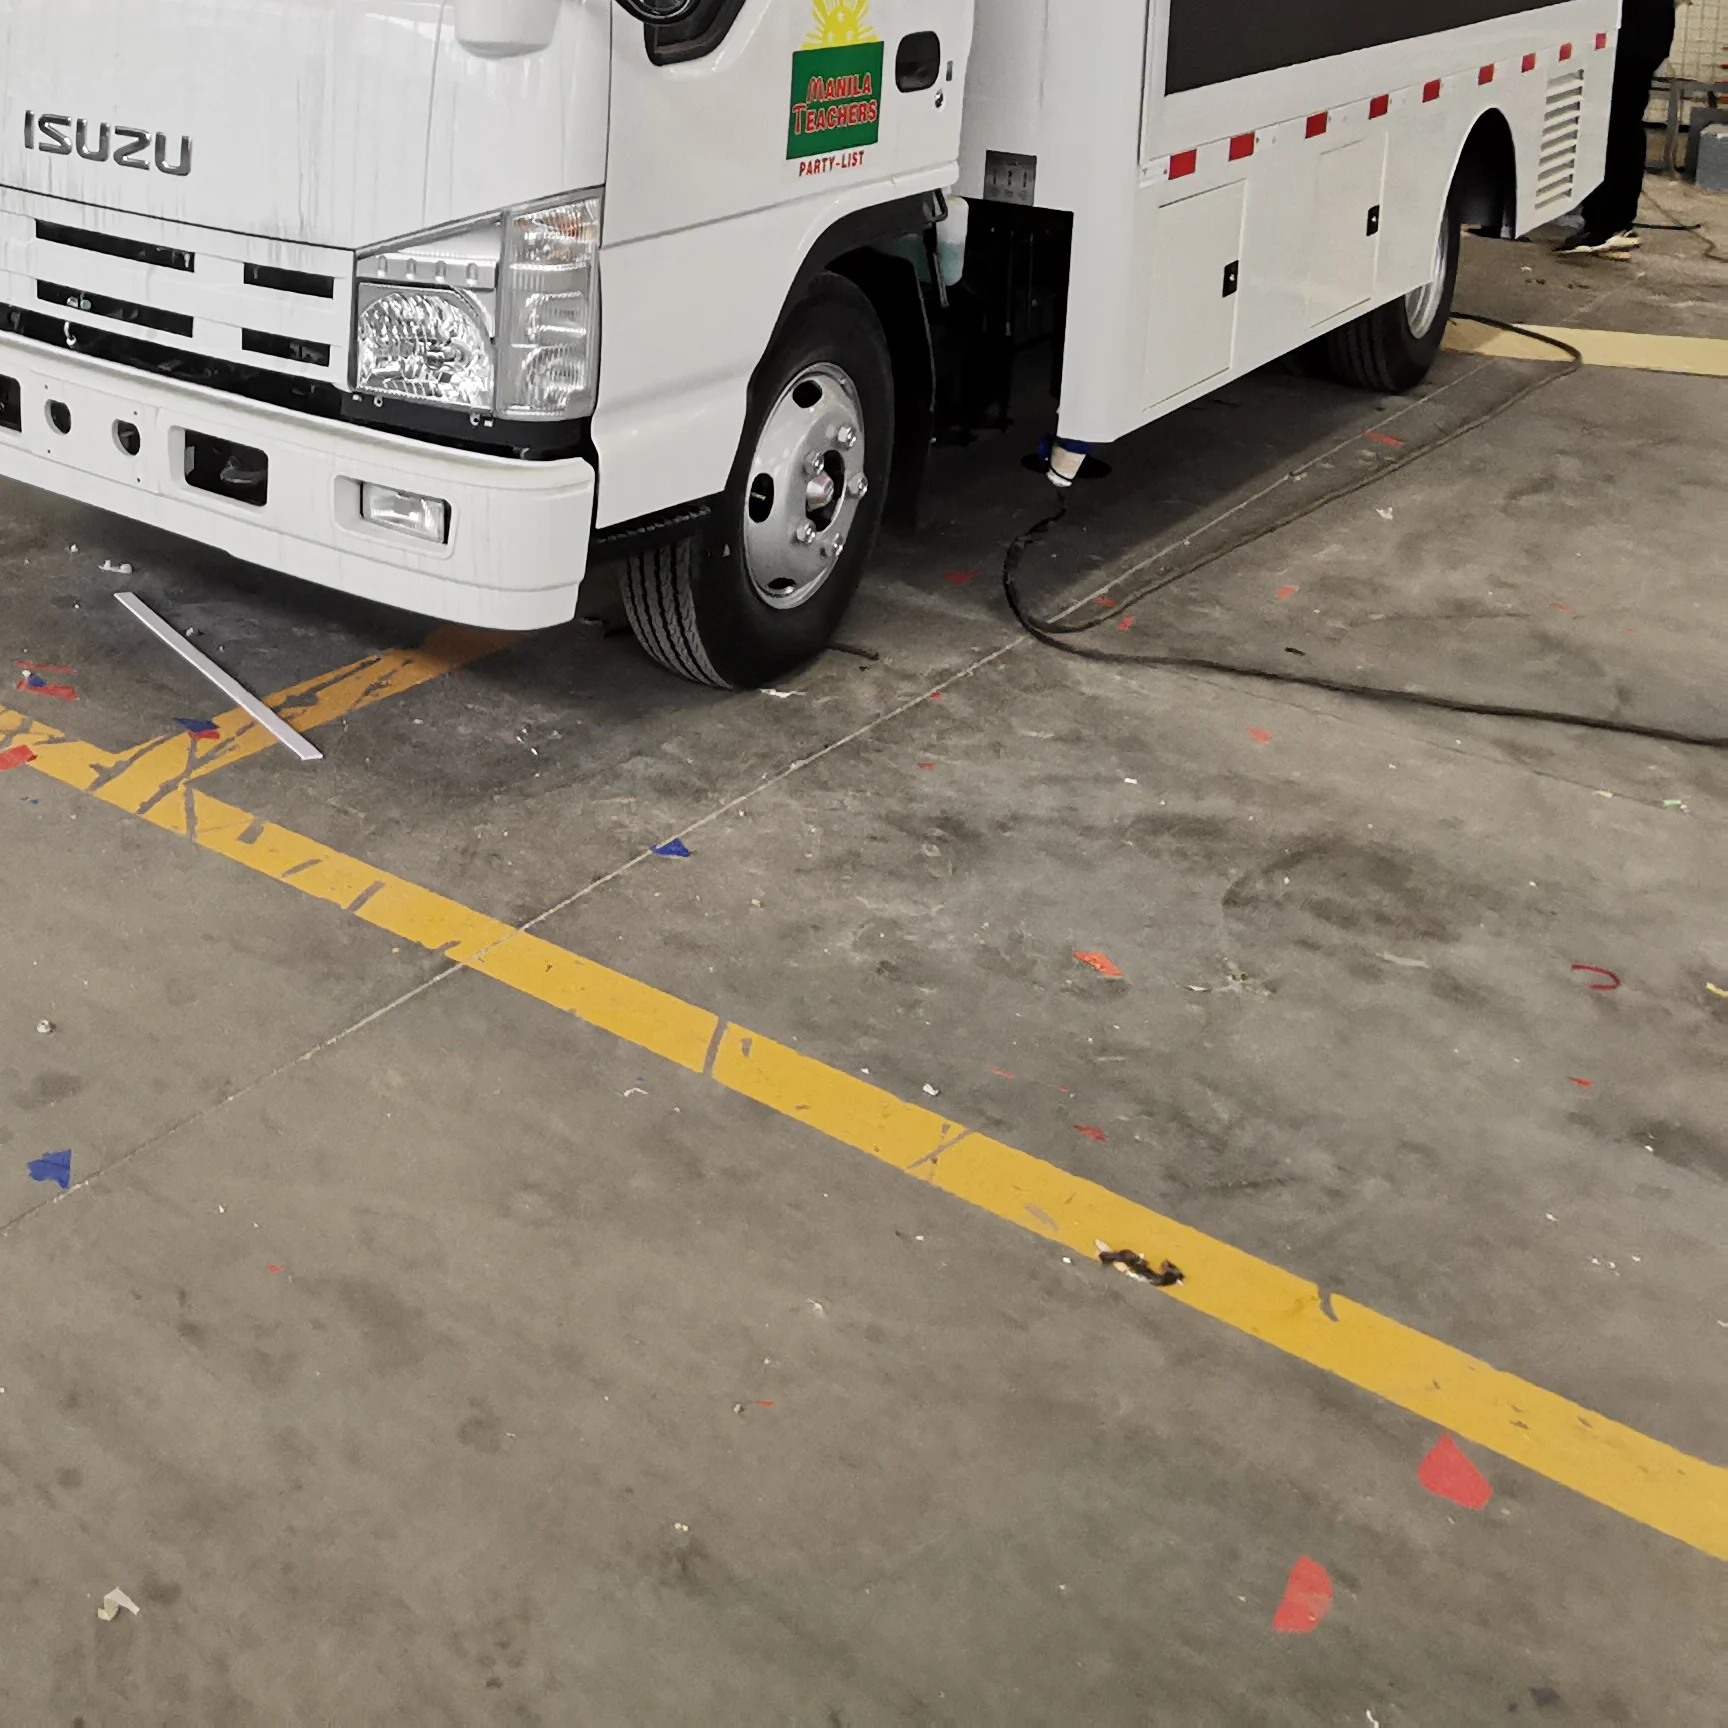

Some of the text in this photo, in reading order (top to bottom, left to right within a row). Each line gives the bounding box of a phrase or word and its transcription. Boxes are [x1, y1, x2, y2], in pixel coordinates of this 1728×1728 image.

[806, 72, 873, 104] MANILA
[792, 98, 878, 135] TEACHERS
[23, 109, 193, 177] ISUZU
[798, 150, 865, 178] PARTY-LIST
